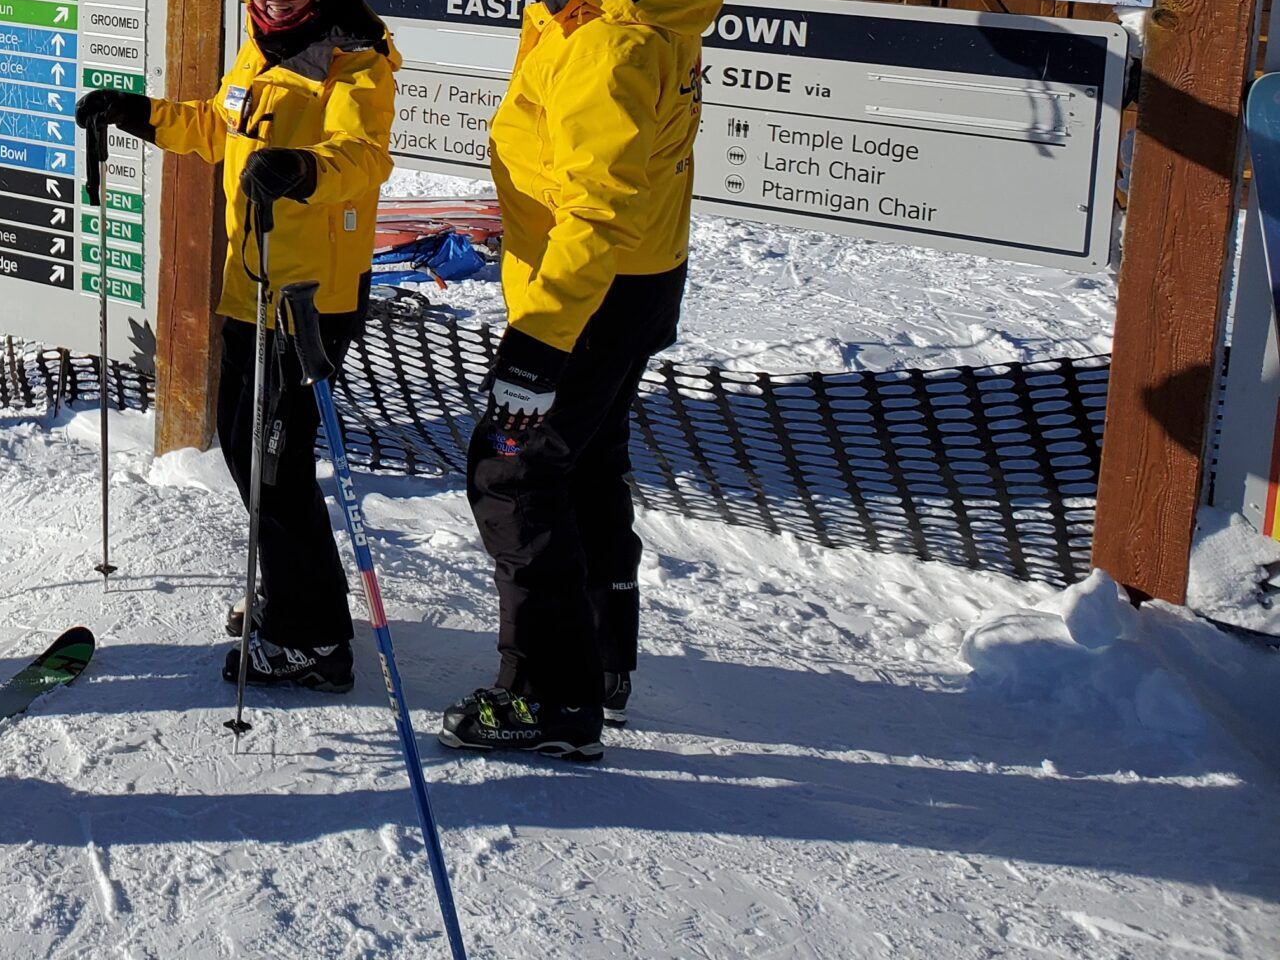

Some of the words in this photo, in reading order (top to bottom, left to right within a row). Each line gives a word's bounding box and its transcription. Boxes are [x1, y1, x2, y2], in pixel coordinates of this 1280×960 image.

[90, 14, 139, 29] GROOMED
[90, 44, 139, 59] GROOMED
[91, 73, 134, 90] OPEN
[722, 67, 792, 93] SIDE
[804, 83, 831, 98] via
[449, 86, 502, 109] Parkin
[399, 106, 418, 121] of
[423, 109, 450, 126] the
[108, 135, 139, 150] OMED
[389, 130, 437, 151] yjack
[444, 137, 491, 161] Lodge
[767, 124, 843, 152] Temple
[851, 133, 919, 162] Lodge
[0, 145, 27, 162] Bowl
[763, 152, 819, 177] Larch
[828, 159, 886, 187] Chair
[106, 193, 132, 209] PEN
[762, 180, 870, 214] Ptarmigan
[878, 194, 938, 222] Chair
[508, 365, 538, 382] Auclair
[503, 388, 531, 402] Auclair
